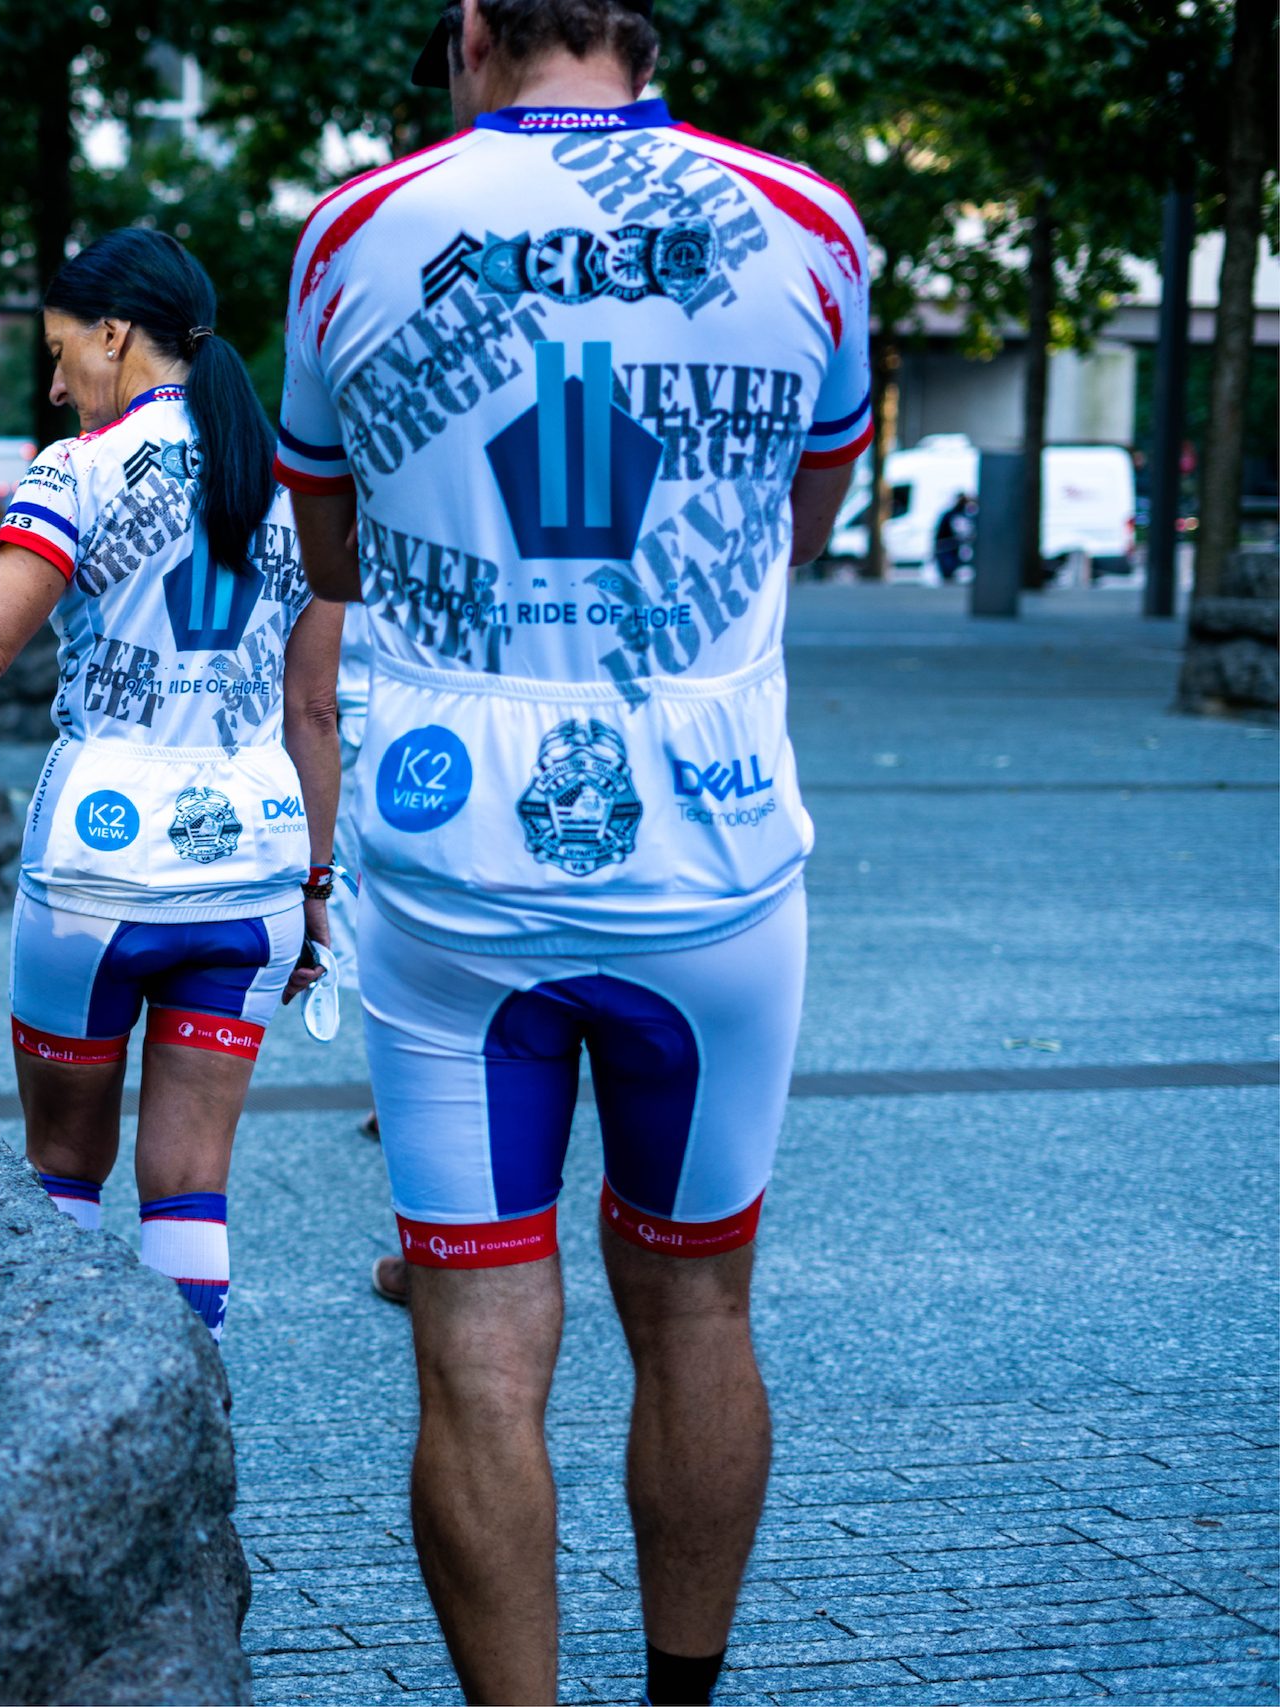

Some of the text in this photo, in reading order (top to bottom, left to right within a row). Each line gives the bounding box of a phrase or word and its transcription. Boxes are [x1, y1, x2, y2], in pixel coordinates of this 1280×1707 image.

[519, 112, 627, 129] STIGMA
[3, 515, 32, 529] 43
[533, 577, 548, 589] PA
[517, 603, 577, 625] RIDE
[586, 604, 624, 626] OF
[138, 663, 151, 671] NY
[126, 681, 162, 696] 9/11
[206, 680, 227, 694] OF
[231, 681, 270, 695] HOPE
[396, 746, 452, 790] K2
[673, 754, 773, 802] DELL
[88, 802, 126, 828] K2
[262, 796, 305, 820] DEL
[570, 860, 588, 870] VA
[197, 1030, 213, 1038] THE
[216, 1028, 252, 1048] Quell
[38, 1042, 74, 1061] Quell
[638, 1223, 684, 1246] Quell
[429, 1236, 478, 1260] Quell
